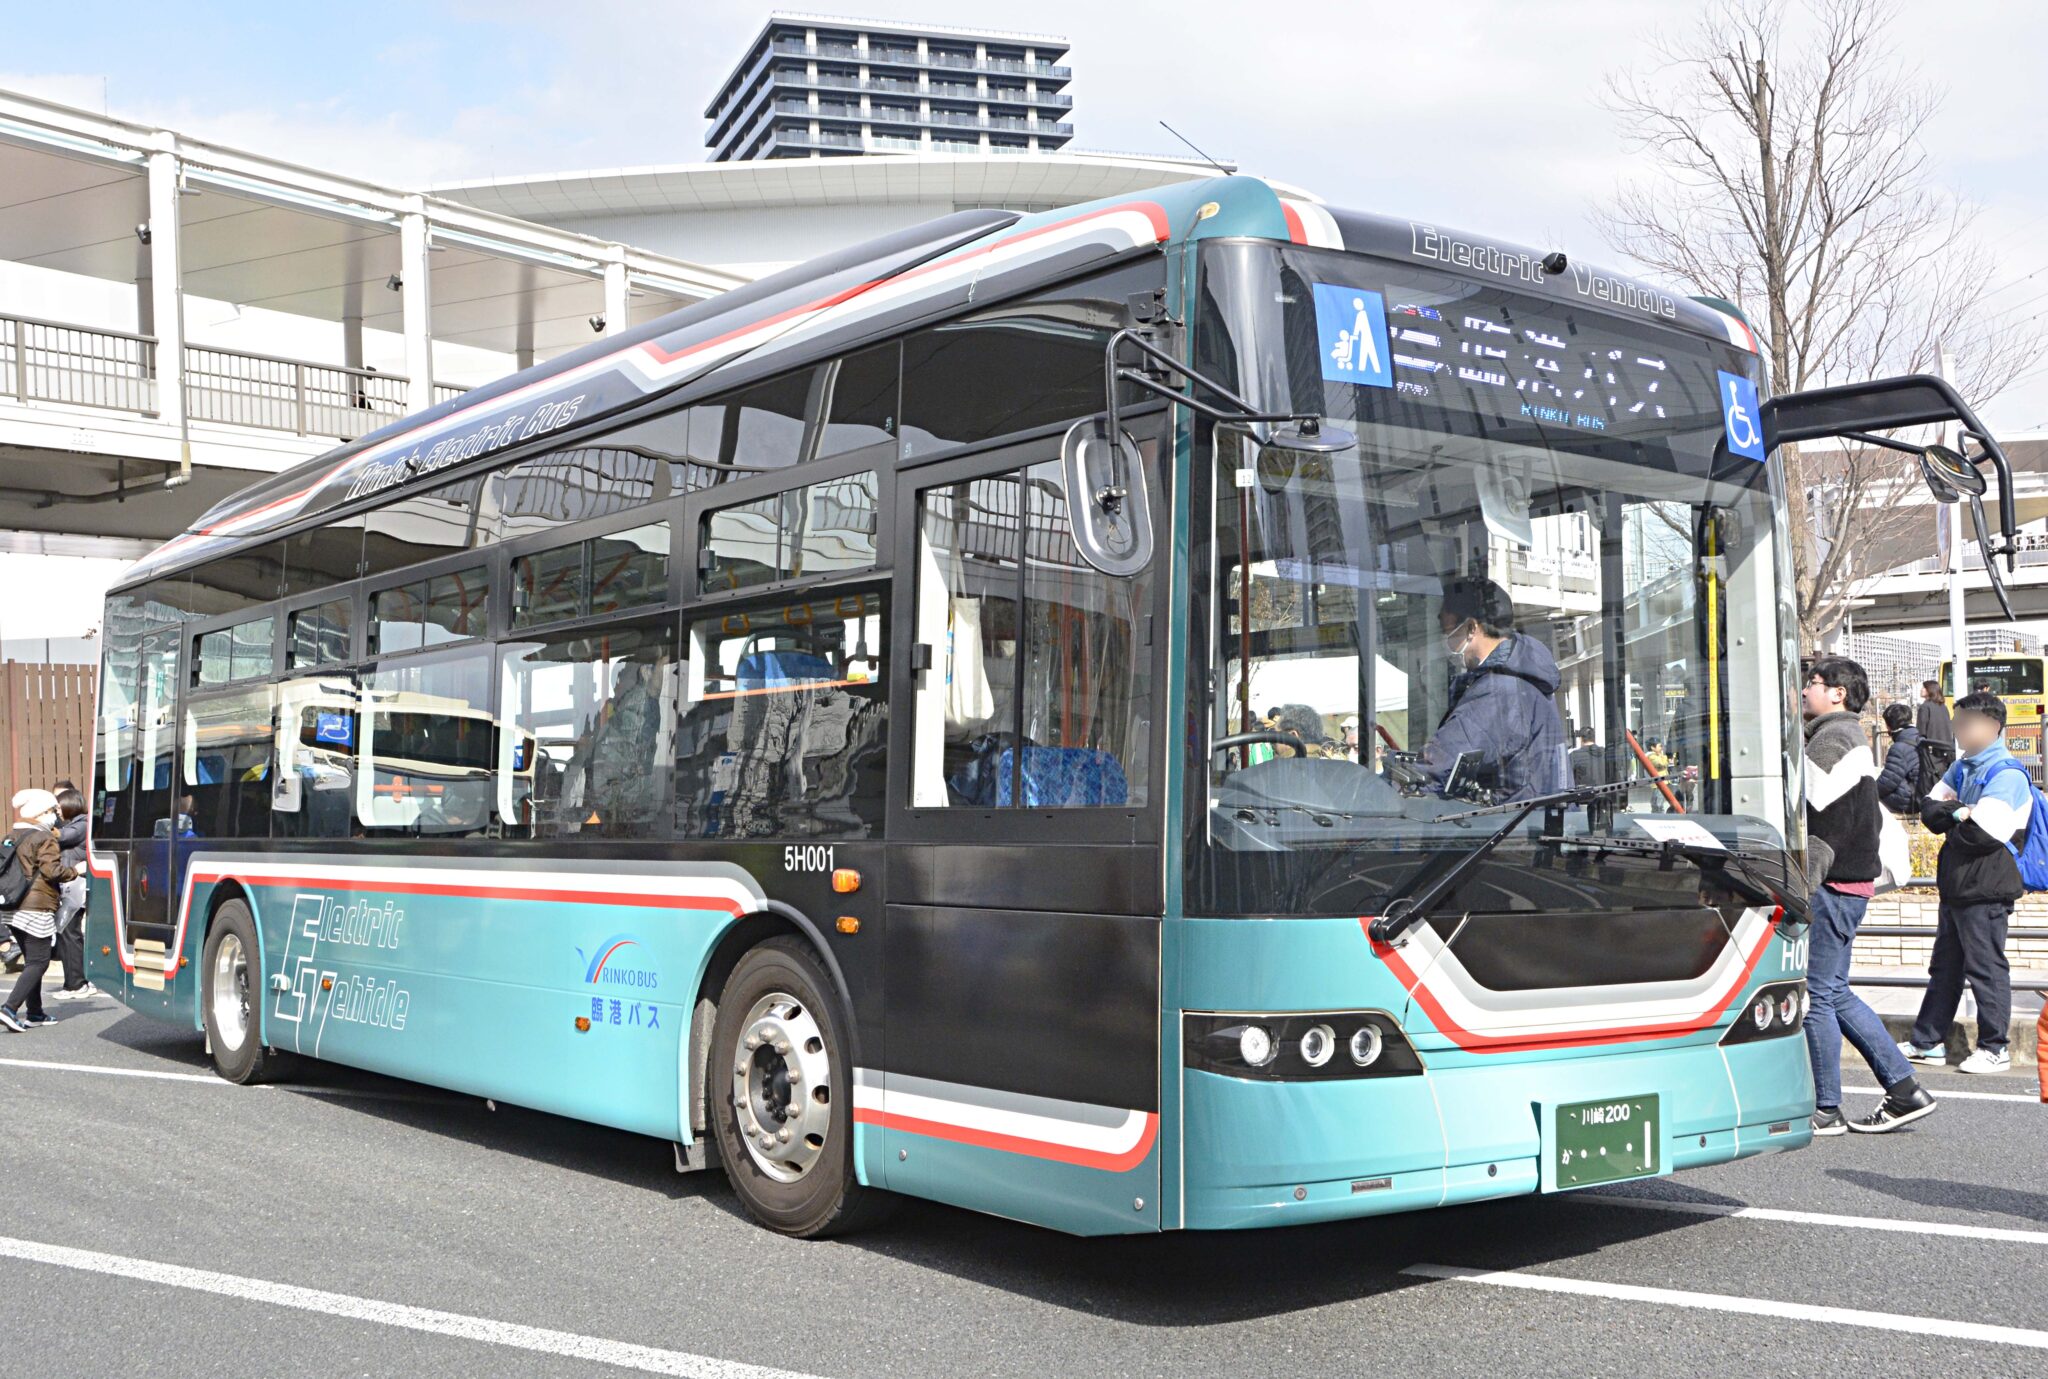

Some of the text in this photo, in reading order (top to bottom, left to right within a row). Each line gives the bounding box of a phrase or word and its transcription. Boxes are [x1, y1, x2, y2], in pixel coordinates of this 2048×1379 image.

[1409, 222, 1676, 319] Electric Vehicle
[416, 415, 524, 475] Electric
[519, 395, 585, 440] Bus
[784, 845, 833, 872] 5H001
[275, 893, 404, 1022] Electric
[296, 968, 410, 1058] Vehicle
[591, 997, 659, 1029] 臨港バス
